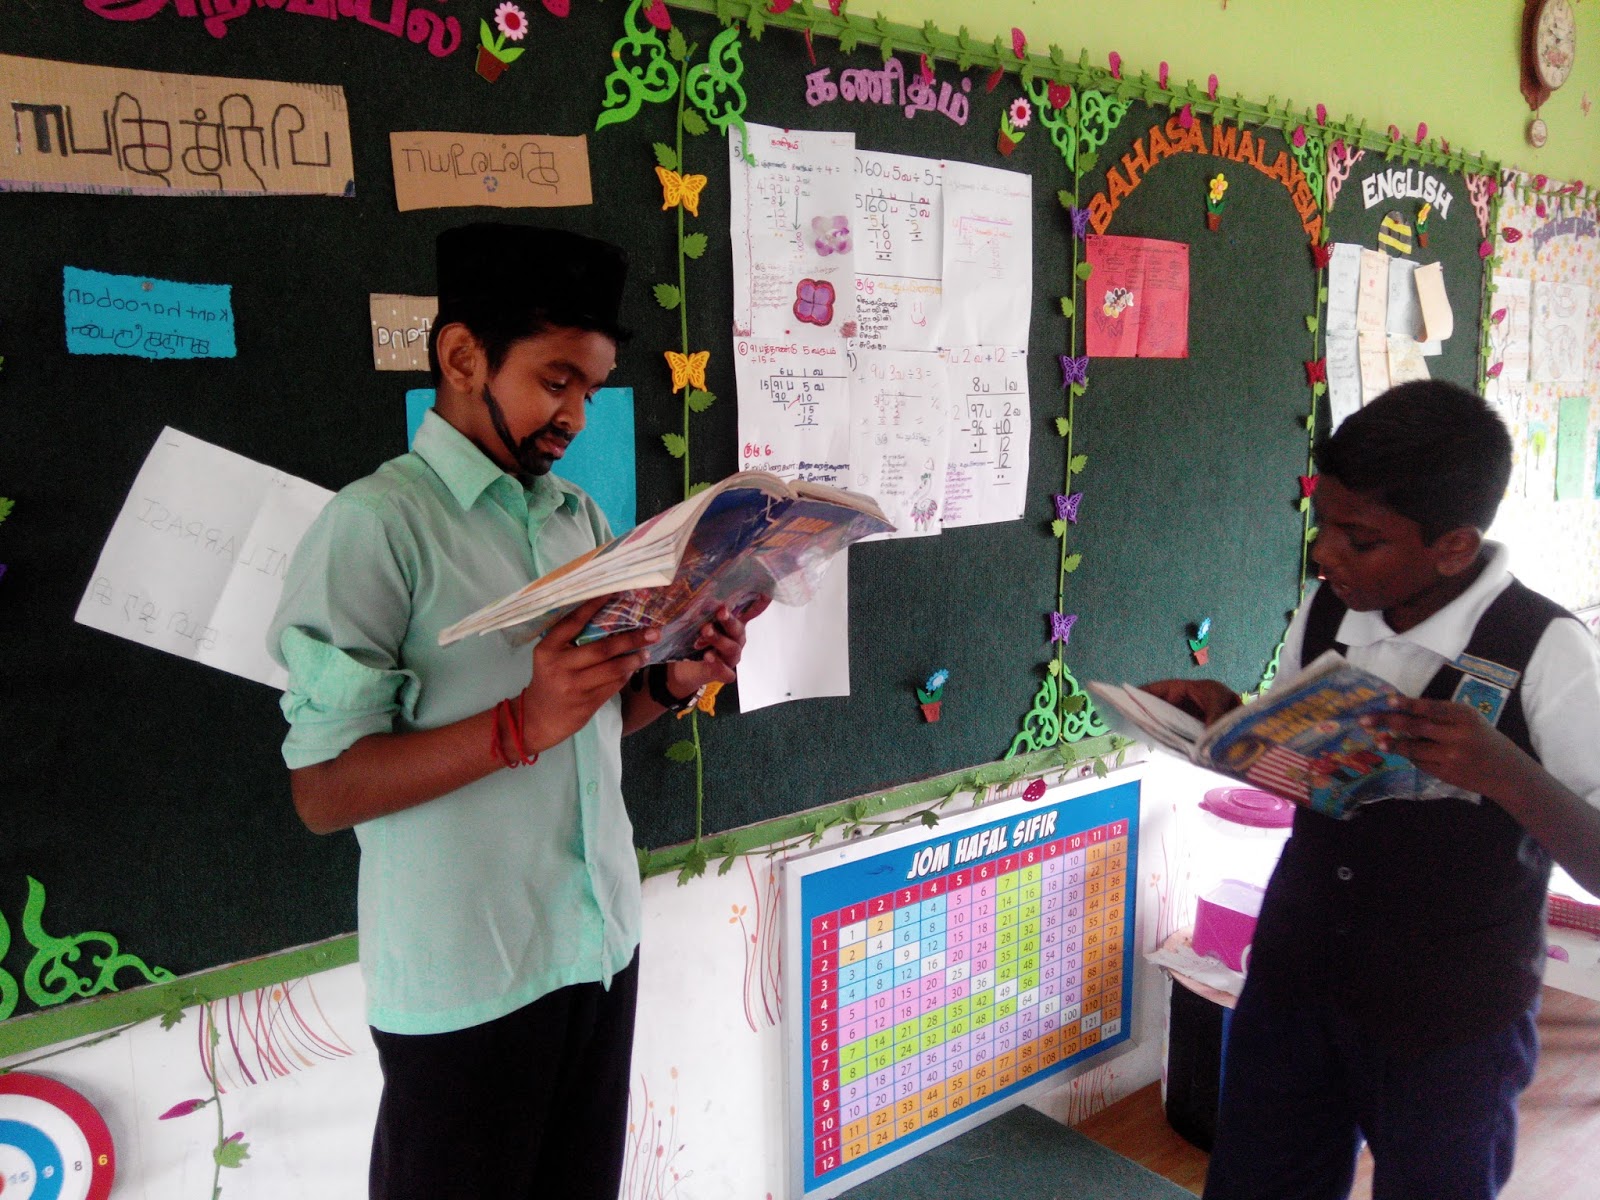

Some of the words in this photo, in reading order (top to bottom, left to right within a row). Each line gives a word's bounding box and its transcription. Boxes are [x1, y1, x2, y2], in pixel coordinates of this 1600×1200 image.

[805, 57, 972, 126] கணிதம்
[825, 166, 833, 174] 4
[1089, 116, 1206, 235] BAHASA
[1211, 126, 1323, 246] MALAYSIA
[855, 193, 863, 208] 5
[1361, 168, 1453, 220] ENGLISH
[760, 380, 769, 391] 15
[907, 845, 949, 880] JOM
[955, 829, 1008, 865] HAFAL
[1013, 810, 1058, 847] SIFIR
[877, 900, 884, 911] 2
[904, 891, 911, 902] 3
[931, 883, 937, 893] 4
[956, 875, 963, 885] 5
[981, 867, 987, 877] 6
[1005, 859, 1011, 870] 7
[1027, 852, 1034, 862] 8
[1050, 845, 1057, 855] 9
[1071, 837, 1080, 848] 10
[1094, 831, 1100, 840] 11
[1113, 825, 1121, 835] 12
[877, 920, 883, 931] 2
[904, 911, 910, 922] 3
[930, 903, 937, 912] 4
[956, 894, 962, 905] 5
[980, 886, 987, 896] 6
[1004, 878, 1011, 888] 7
[1027, 871, 1033, 880] 8
[1049, 864, 1055, 873] 9
[1069, 856, 1078, 866] 10
[1093, 849, 1100, 859] 11
[1112, 842, 1121, 852] 12
[822, 960, 828, 971] 2
[849, 950, 856, 961] 2
[877, 940, 883, 951] 4
[904, 931, 910, 941] 6
[930, 922, 936, 932] 8
[953, 913, 963, 924] 10
[977, 905, 987, 915] 12
[1002, 897, 1011, 907] 14
[1025, 888, 1034, 899] 16
[1047, 881, 1056, 891] 18
[1068, 873, 1078, 884] 20
[1090, 866, 1100, 877] 22
[1111, 860, 1120, 870] 24
[821, 980, 828, 991] 3
[849, 970, 856, 980] 3
[877, 960, 883, 970] 6
[904, 950, 910, 961] 9
[927, 940, 938, 951] 12
[953, 931, 963, 942] 15
[977, 923, 987, 933] 18
[1002, 914, 1011, 926] 21
[1025, 906, 1034, 917] 24
[1047, 898, 1056, 909] 27
[1068, 890, 1077, 901] 30
[1089, 883, 1099, 893] 33
[1110, 876, 1120, 886] 36
[821, 1000, 827, 1010] 4
[849, 989, 856, 1000] 4
[877, 979, 883, 990] 8
[901, 968, 912, 980] 12
[926, 959, 938, 970] 16
[953, 950, 963, 962] 20
[977, 941, 987, 953] 24
[1001, 932, 1010, 944] 28
[1025, 924, 1034, 934] 32
[1046, 916, 1055, 926] 36
[1067, 908, 1077, 917] 40
[1089, 900, 1098, 910] 44
[1110, 893, 1119, 903] 48
[821, 1019, 828, 1031] 5
[821, 1039, 828, 1050] 6
[822, 1059, 828, 1071] 7
[823, 1079, 829, 1090] 8
[823, 1100, 829, 1111] 9
[822, 1118, 833, 1131] 10
[822, 1138, 832, 1150] 11
[74, 1160, 83, 1171] 8
[98, 1154, 108, 1166] 6
[823, 1157, 834, 1170] 12
